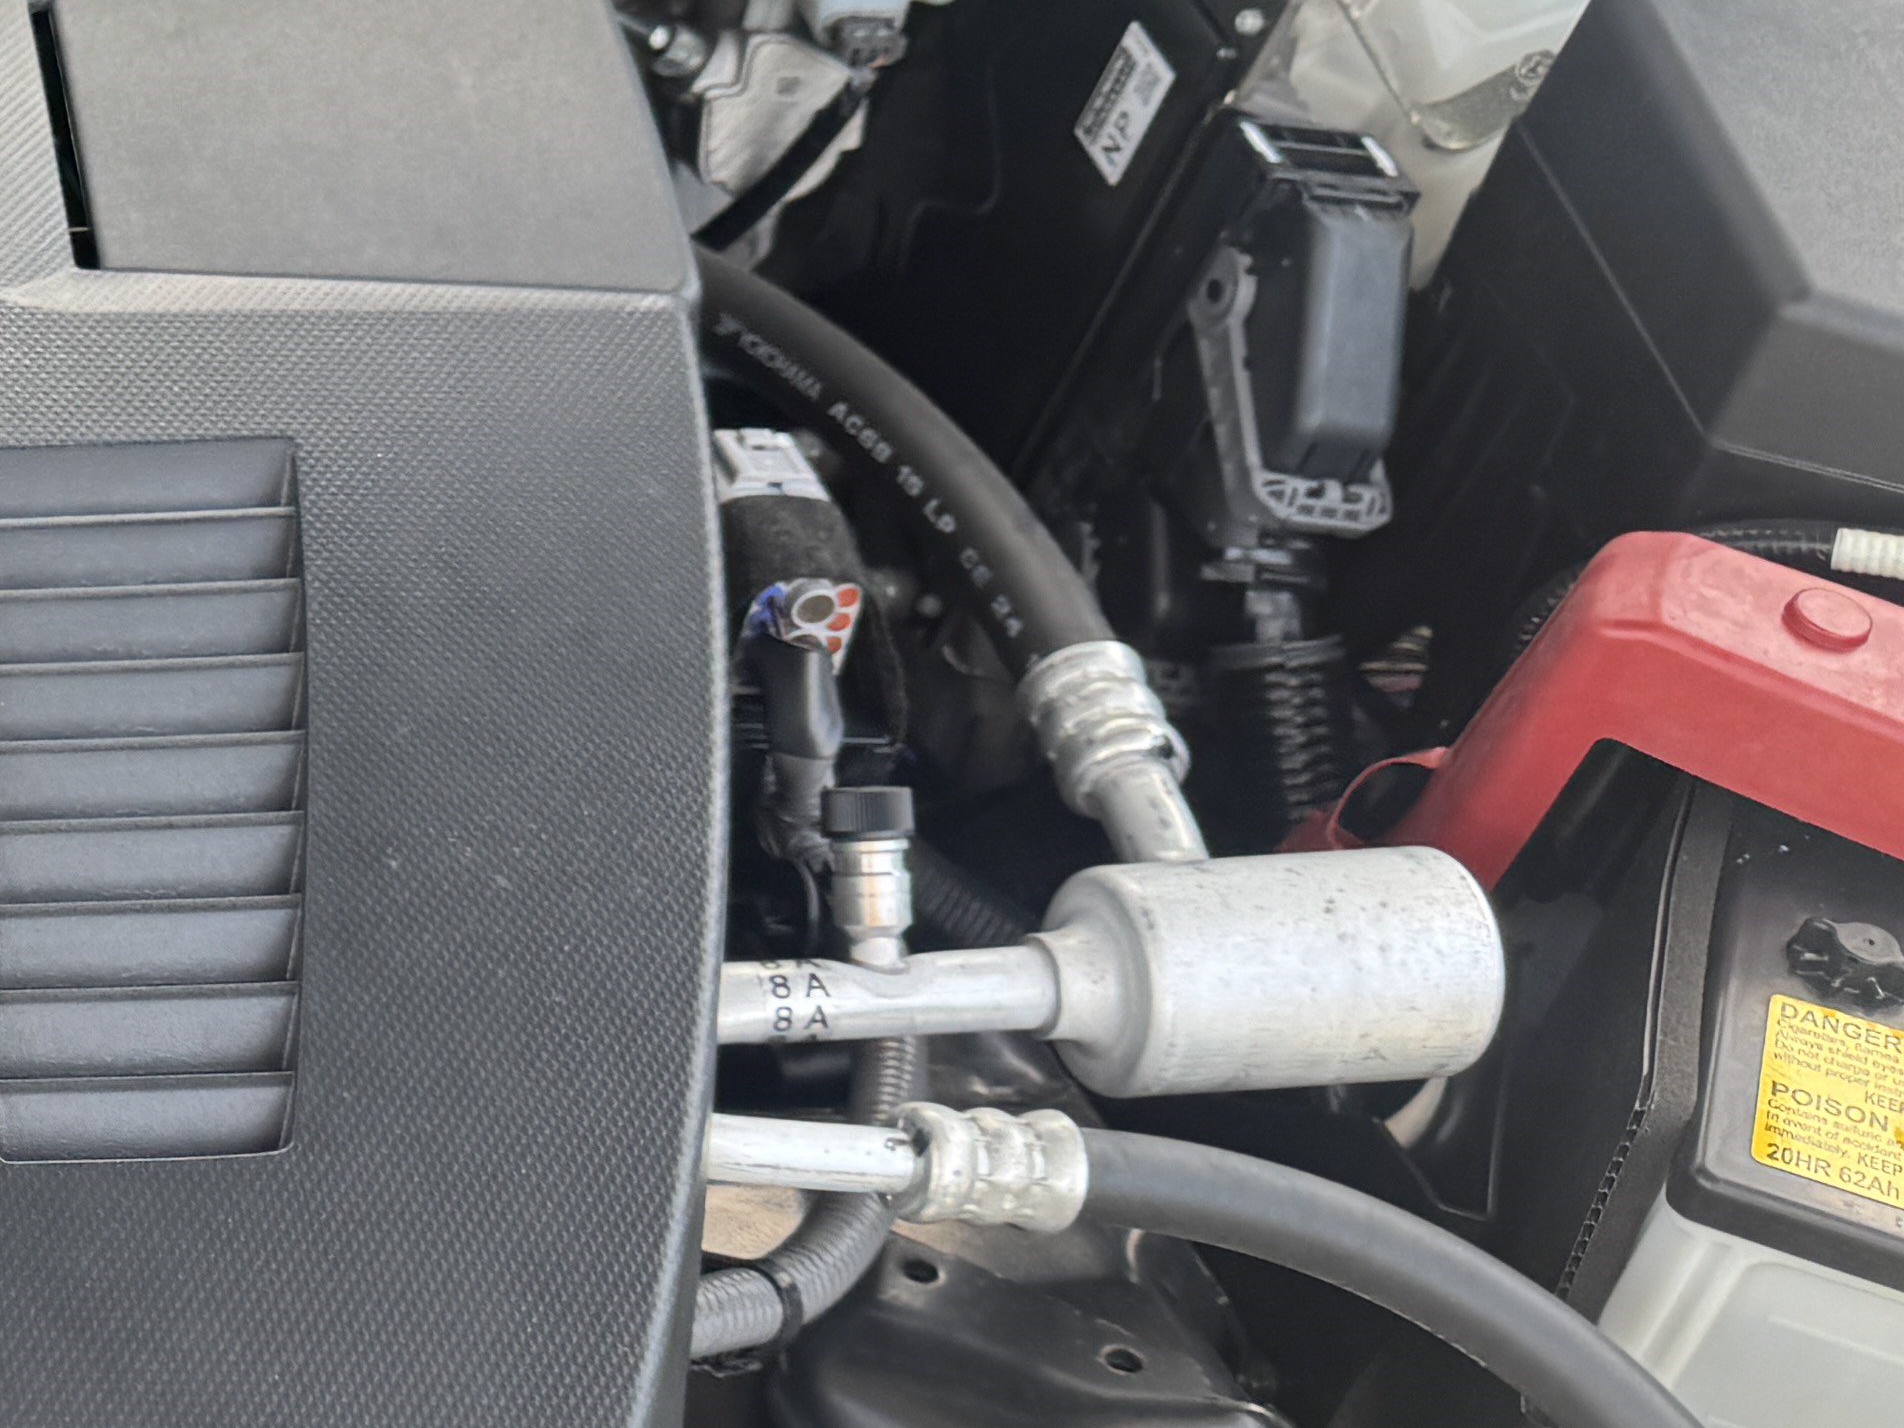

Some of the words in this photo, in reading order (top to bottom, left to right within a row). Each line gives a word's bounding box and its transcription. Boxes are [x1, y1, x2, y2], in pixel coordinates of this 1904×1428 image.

[1780, 1002, 1904, 1053] DANGER
[1771, 1079, 1889, 1134] POISON
[1766, 1142, 1831, 1179] 20HR
[1839, 1163, 1900, 1200] 62Ah
[1858, 1152, 1903, 1177] KEEP
